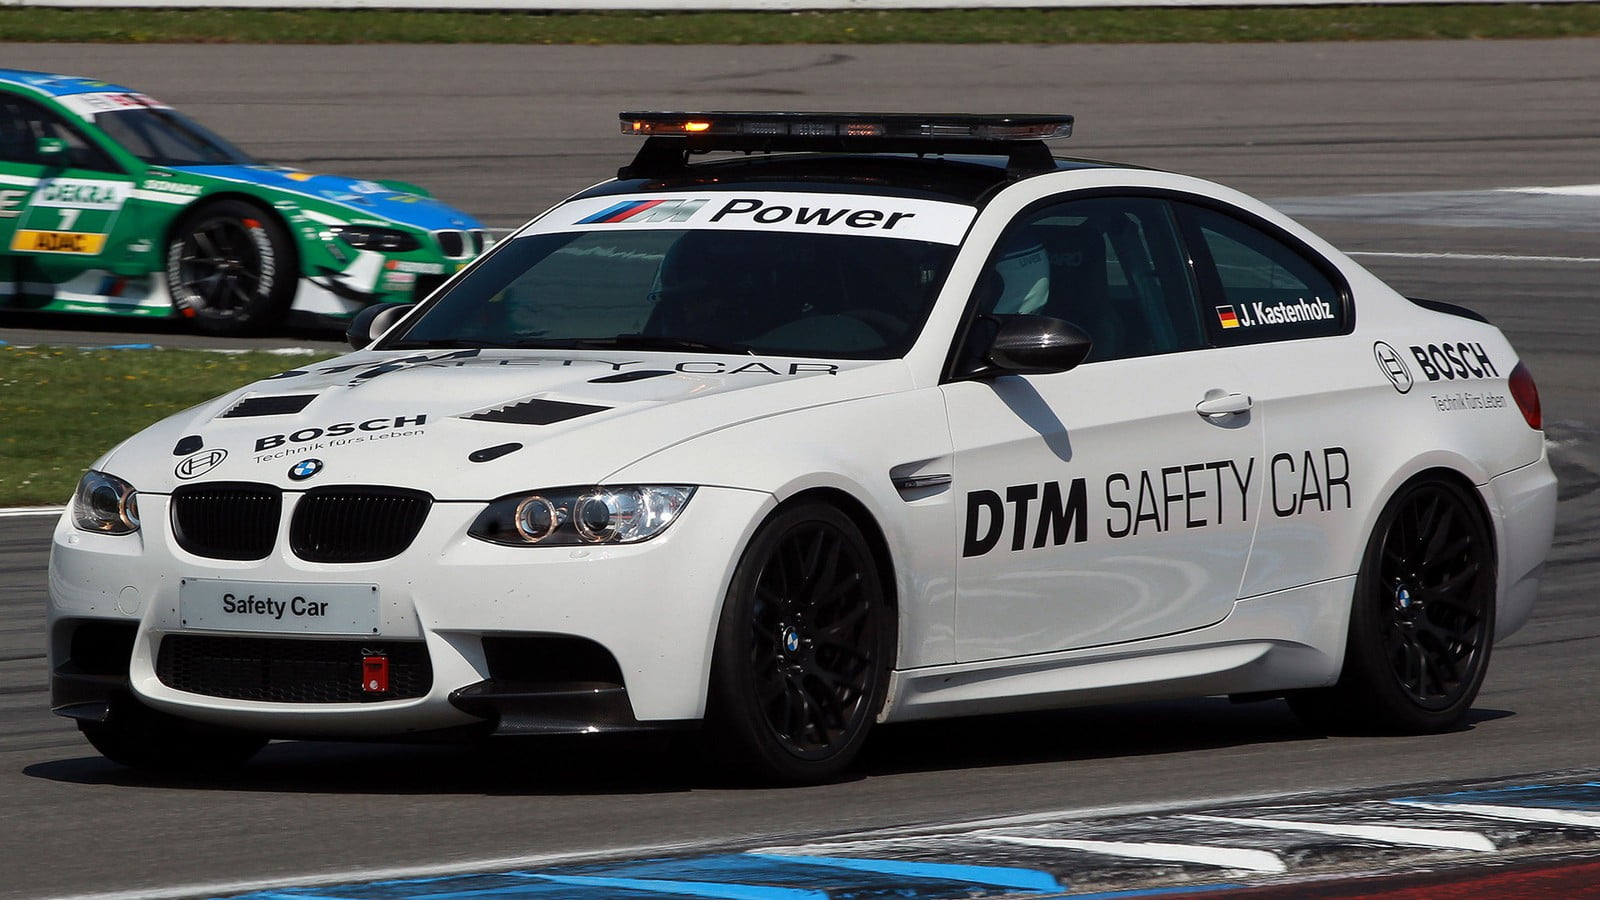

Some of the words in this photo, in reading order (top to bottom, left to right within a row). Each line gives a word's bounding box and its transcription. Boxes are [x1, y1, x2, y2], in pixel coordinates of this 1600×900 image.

[709, 199, 915, 230] Power
[1240, 303, 1256, 327] J.
[1253, 296, 1335, 325] Kastenholz
[675, 361, 839, 376] CAR
[1409, 342, 1500, 382] BOSCH
[1431, 393, 1467, 412] Technik
[1465, 392, 1483, 411] fürs
[1482, 392, 1508, 409] Leben
[253, 442, 325, 465] Technik
[328, 434, 365, 449] fürs
[369, 428, 425, 442] Leben
[254, 414, 427, 451] BOSCH
[962, 477, 1089, 559] DTM
[1106, 456, 1255, 540] SAFETY
[1271, 446, 1352, 518] CAR
[222, 593, 286, 620] Safety
[291, 596, 329, 617] Car
